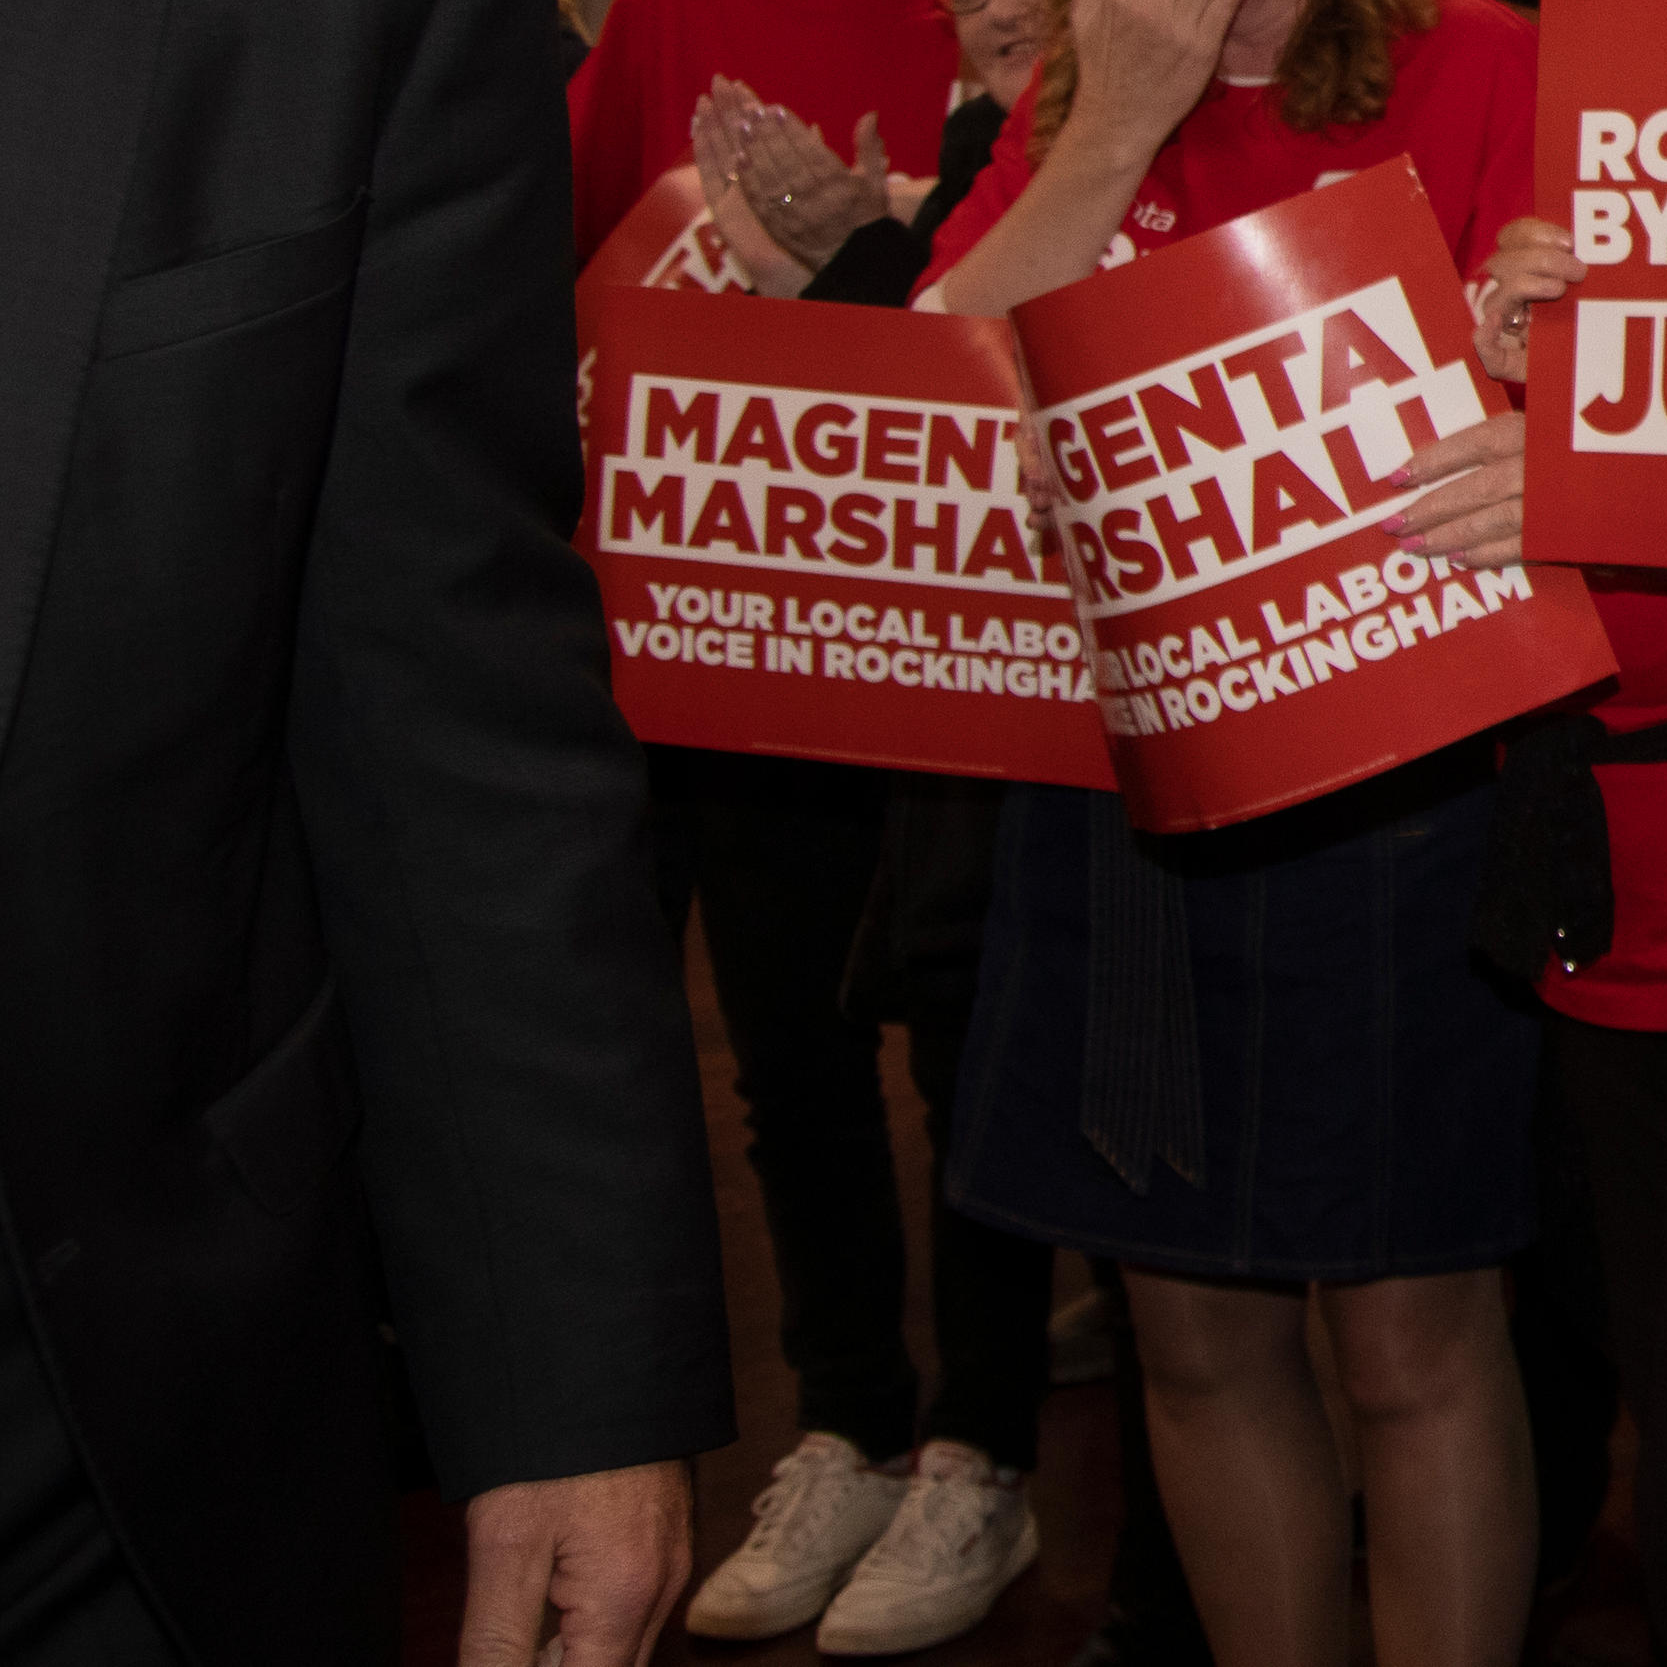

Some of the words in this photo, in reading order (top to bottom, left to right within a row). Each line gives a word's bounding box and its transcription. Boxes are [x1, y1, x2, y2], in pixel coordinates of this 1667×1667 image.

[1047, 307, 1418, 506] GENTA
[616, 620, 757, 673] VOICE
[764, 635, 813, 675] IN
[823, 640, 1098, 705] ROCKINGHA
[647, 582, 774, 636] YOUR
[784, 597, 940, 651] LOCAL
[949, 611, 1088, 663] LABO
[1120, 615, 1260, 688] LOCAL
[1158, 564, 1534, 732] ROCKINGHAM
